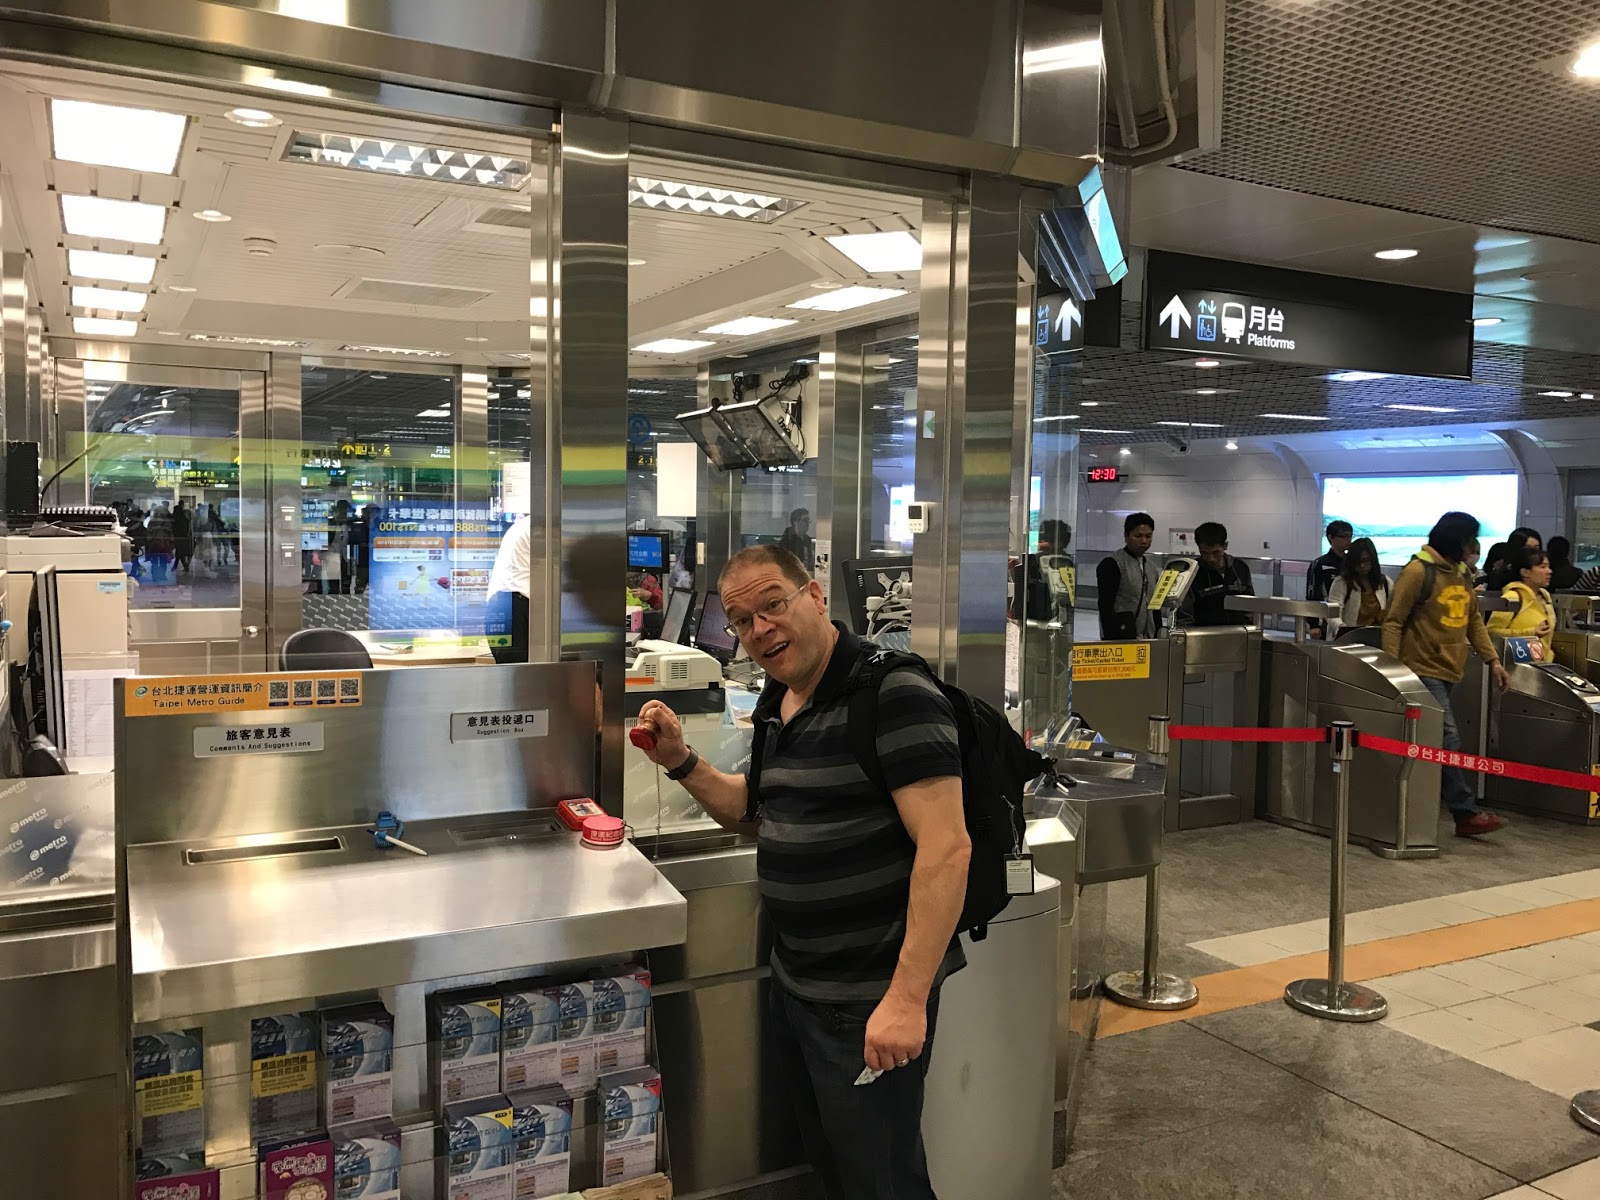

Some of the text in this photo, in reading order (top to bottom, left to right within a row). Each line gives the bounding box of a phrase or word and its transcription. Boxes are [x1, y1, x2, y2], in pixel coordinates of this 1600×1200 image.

[1248, 306, 1284, 333] 月台
[1247, 333, 1296, 350] Platforms
[1091, 467, 1116, 481] 12:30
[151, 682, 264, 697] 台北捷運營運資訊簡介
[153, 696, 245, 709] Taipei Metro Guide
[467, 714, 535, 728] 意見表投遞口
[226, 727, 292, 741] 旅客意見表
[477, 728, 510, 736] Suggestion
[209, 744, 245, 752] Comments
[264, 740, 311, 750] Suggestions
[1421, 747, 1505, 774] 台北捷運公司
[20, 808, 47, 827] metro
[40, 835, 67, 855] metro
